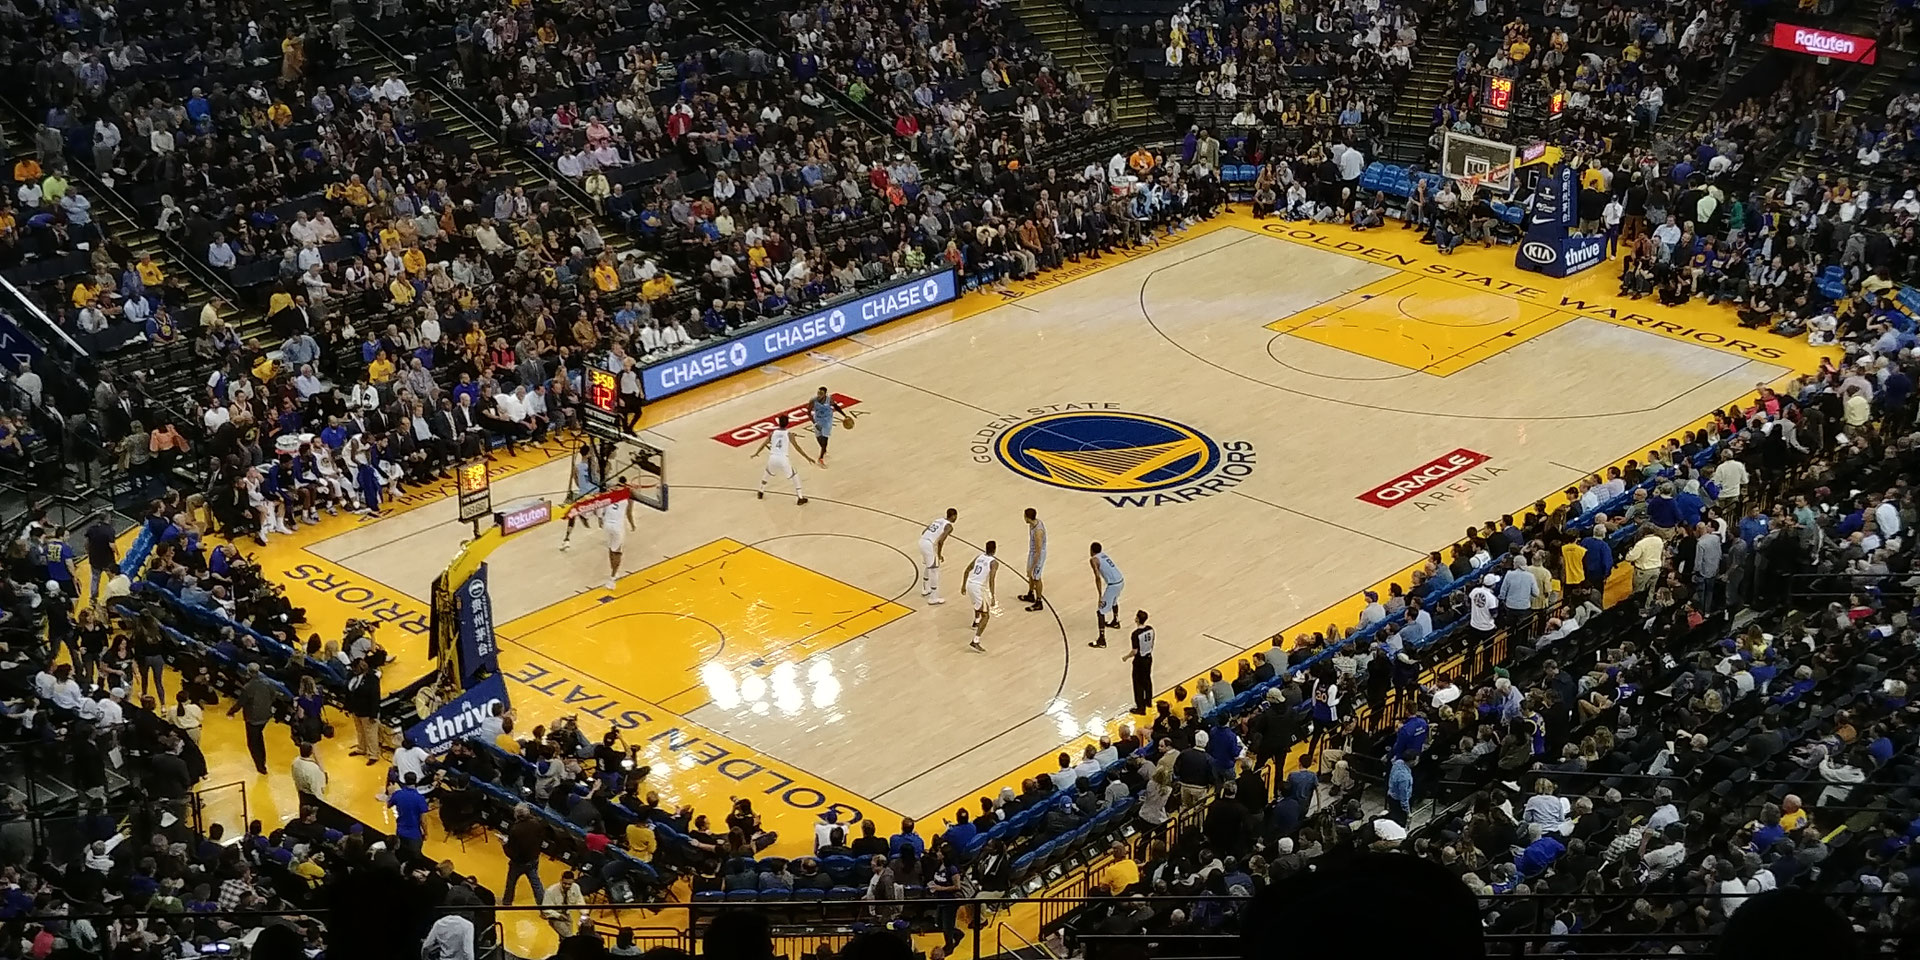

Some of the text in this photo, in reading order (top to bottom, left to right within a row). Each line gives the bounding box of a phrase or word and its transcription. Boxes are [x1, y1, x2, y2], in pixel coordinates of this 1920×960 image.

[1795, 29, 1854, 54] Rakuten
[1491, 78, 1511, 92] 3:58
[1492, 90, 1507, 108] 12
[1528, 245, 1551, 261] KIA
[1565, 243, 1600, 266] thrive
[862, 285, 921, 321] CHASE
[1262, 223, 1417, 266] GOLDEN
[1423, 264, 1547, 299] STATE
[1559, 296, 1787, 359] WARRIORS
[765, 316, 827, 354] CHASE
[593, 371, 614, 390] 3:58
[661, 349, 728, 389] CHASE
[596, 386, 612, 410] 12
[970, 402, 1121, 465] GOLDEN STATE
[1101, 440, 1257, 508] WARRIORS
[1376, 454, 1475, 501] ORACLE
[1413, 465, 1508, 512] ARENA
[507, 506, 548, 530] Rakuten
[282, 563, 430, 635] RRIORS
[505, 662, 652, 729] STATE
[1316, 691, 1327, 703] 30
